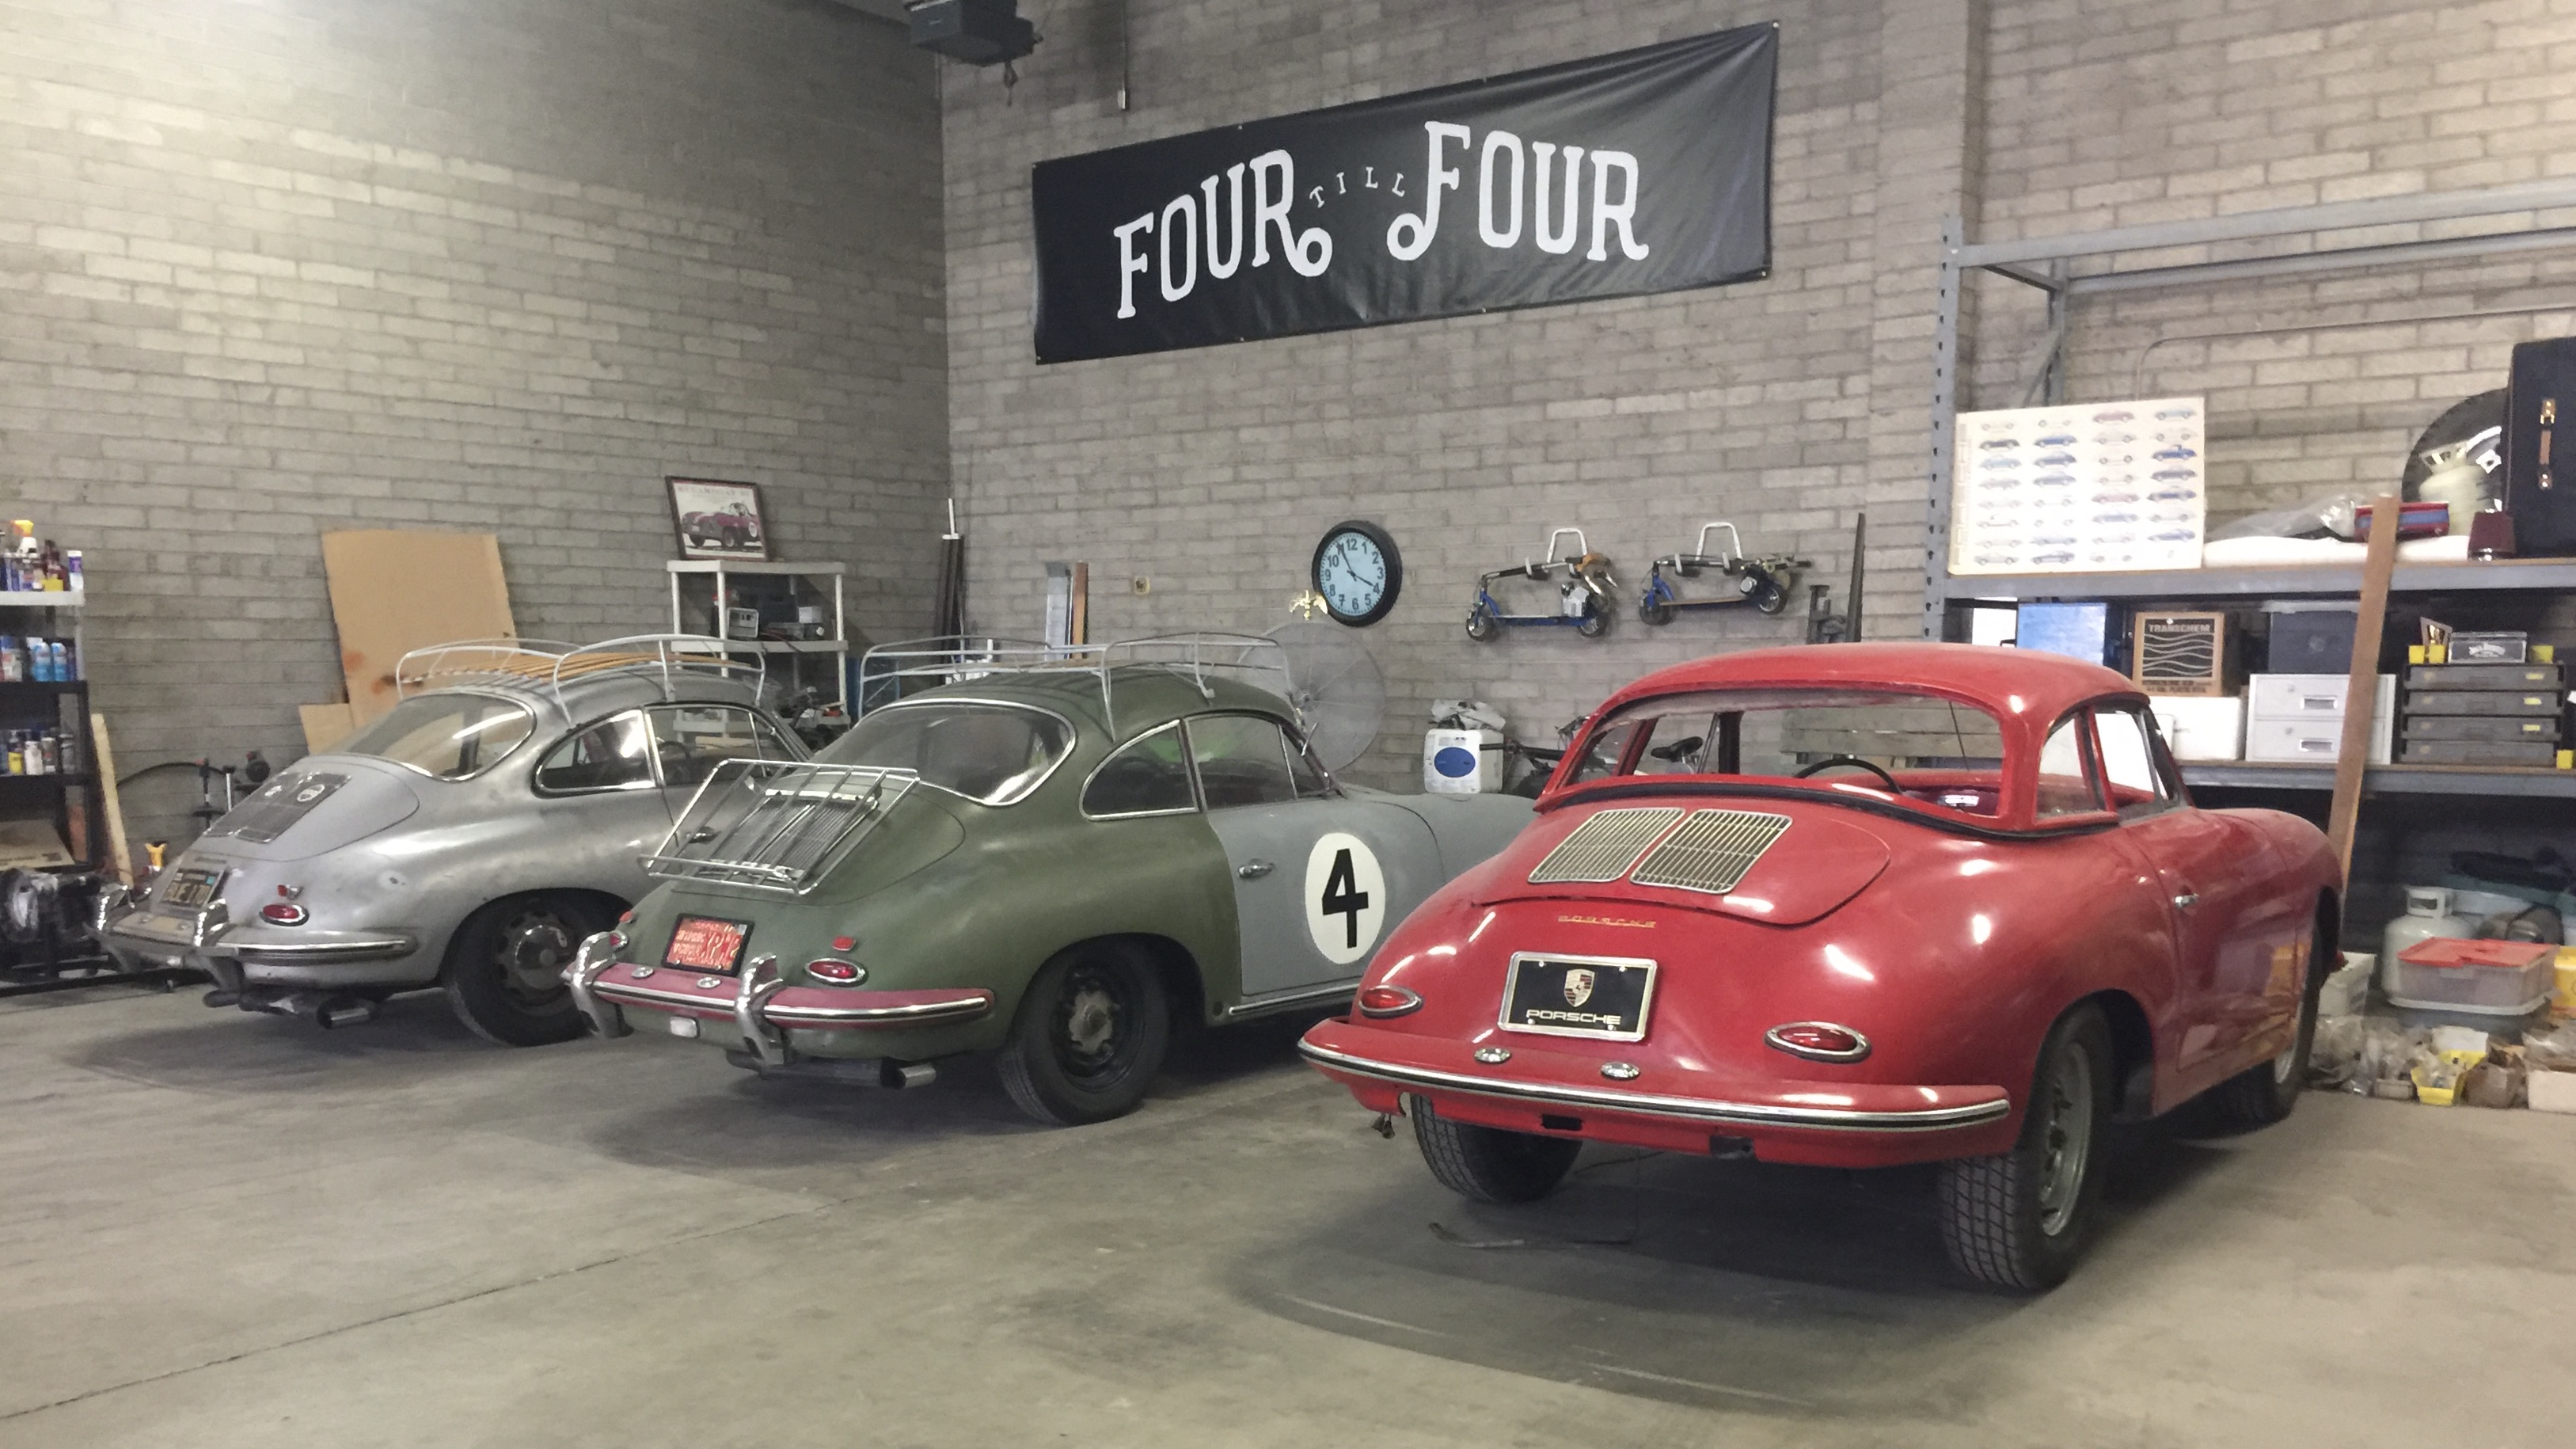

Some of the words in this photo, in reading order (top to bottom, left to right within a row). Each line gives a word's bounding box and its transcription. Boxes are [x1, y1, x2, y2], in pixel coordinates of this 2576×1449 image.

[1113, 149, 1333, 319] FOUR
[1309, 166, 1406, 208] TILL
[1386, 121, 1649, 261] FOUR
[1346, 538, 1358, 550] 12
[1362, 542, 1367, 554] 1
[1328, 555, 1339, 568] 10
[1372, 551, 1379, 564] 2
[1324, 569, 1332, 581] 9
[1377, 567, 1384, 580] 3
[1329, 584, 1336, 596] 8
[1373, 583, 1380, 595] 4
[1339, 594, 1345, 607] 7
[1352, 598, 1359, 610] 6
[1365, 594, 1371, 606] 5
[2149, 624, 2211, 633] TRANSCHEM
[1321, 848, 1369, 949] 4
[1557, 915, 1656, 929] PORSCHE
[1525, 1009, 1622, 1025] PORSCHE
